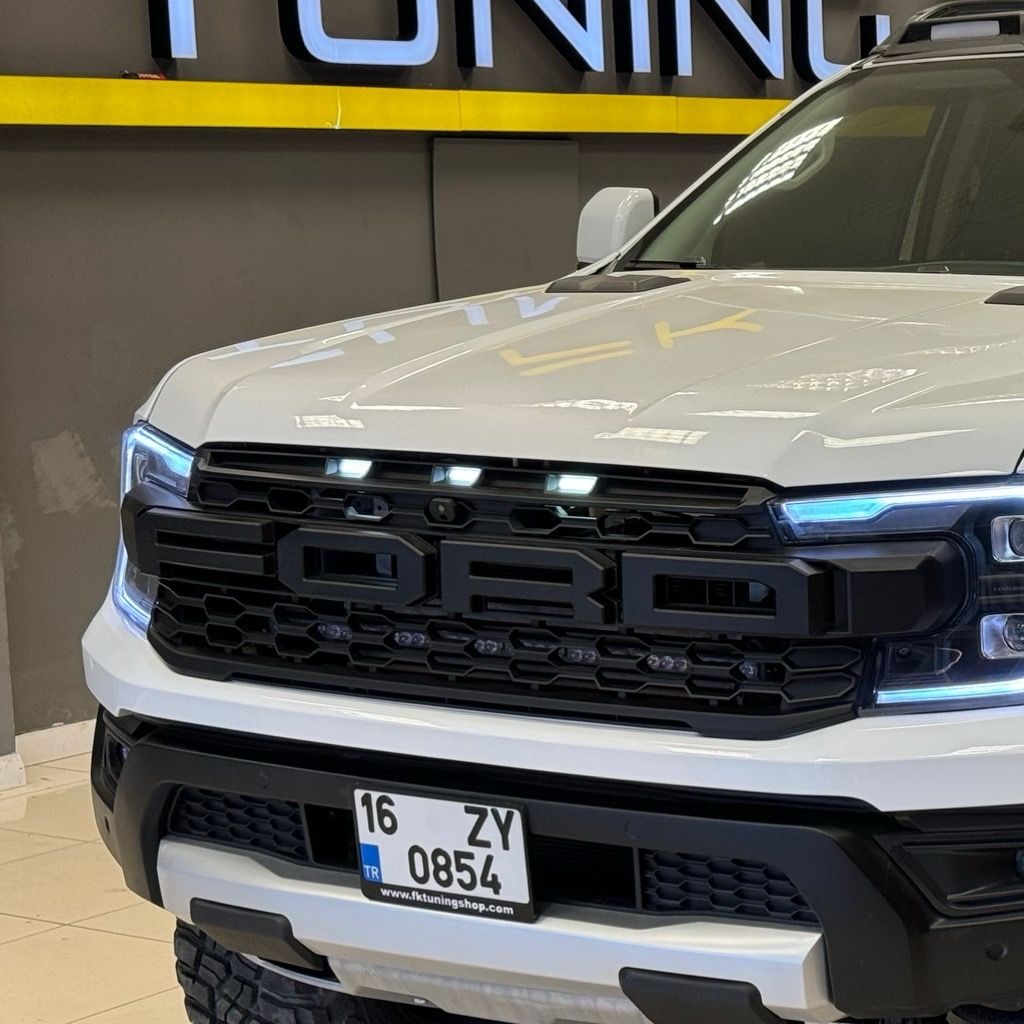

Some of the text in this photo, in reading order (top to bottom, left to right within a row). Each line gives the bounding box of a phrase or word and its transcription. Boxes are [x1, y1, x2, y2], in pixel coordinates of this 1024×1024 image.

[138, 508, 830, 637] FORD
[361, 792, 515, 851] 16 ZY
[363, 864, 380, 880] TR
[407, 844, 502, 895] 0854
[380, 888, 514, 915] www.fktuningshop.com
